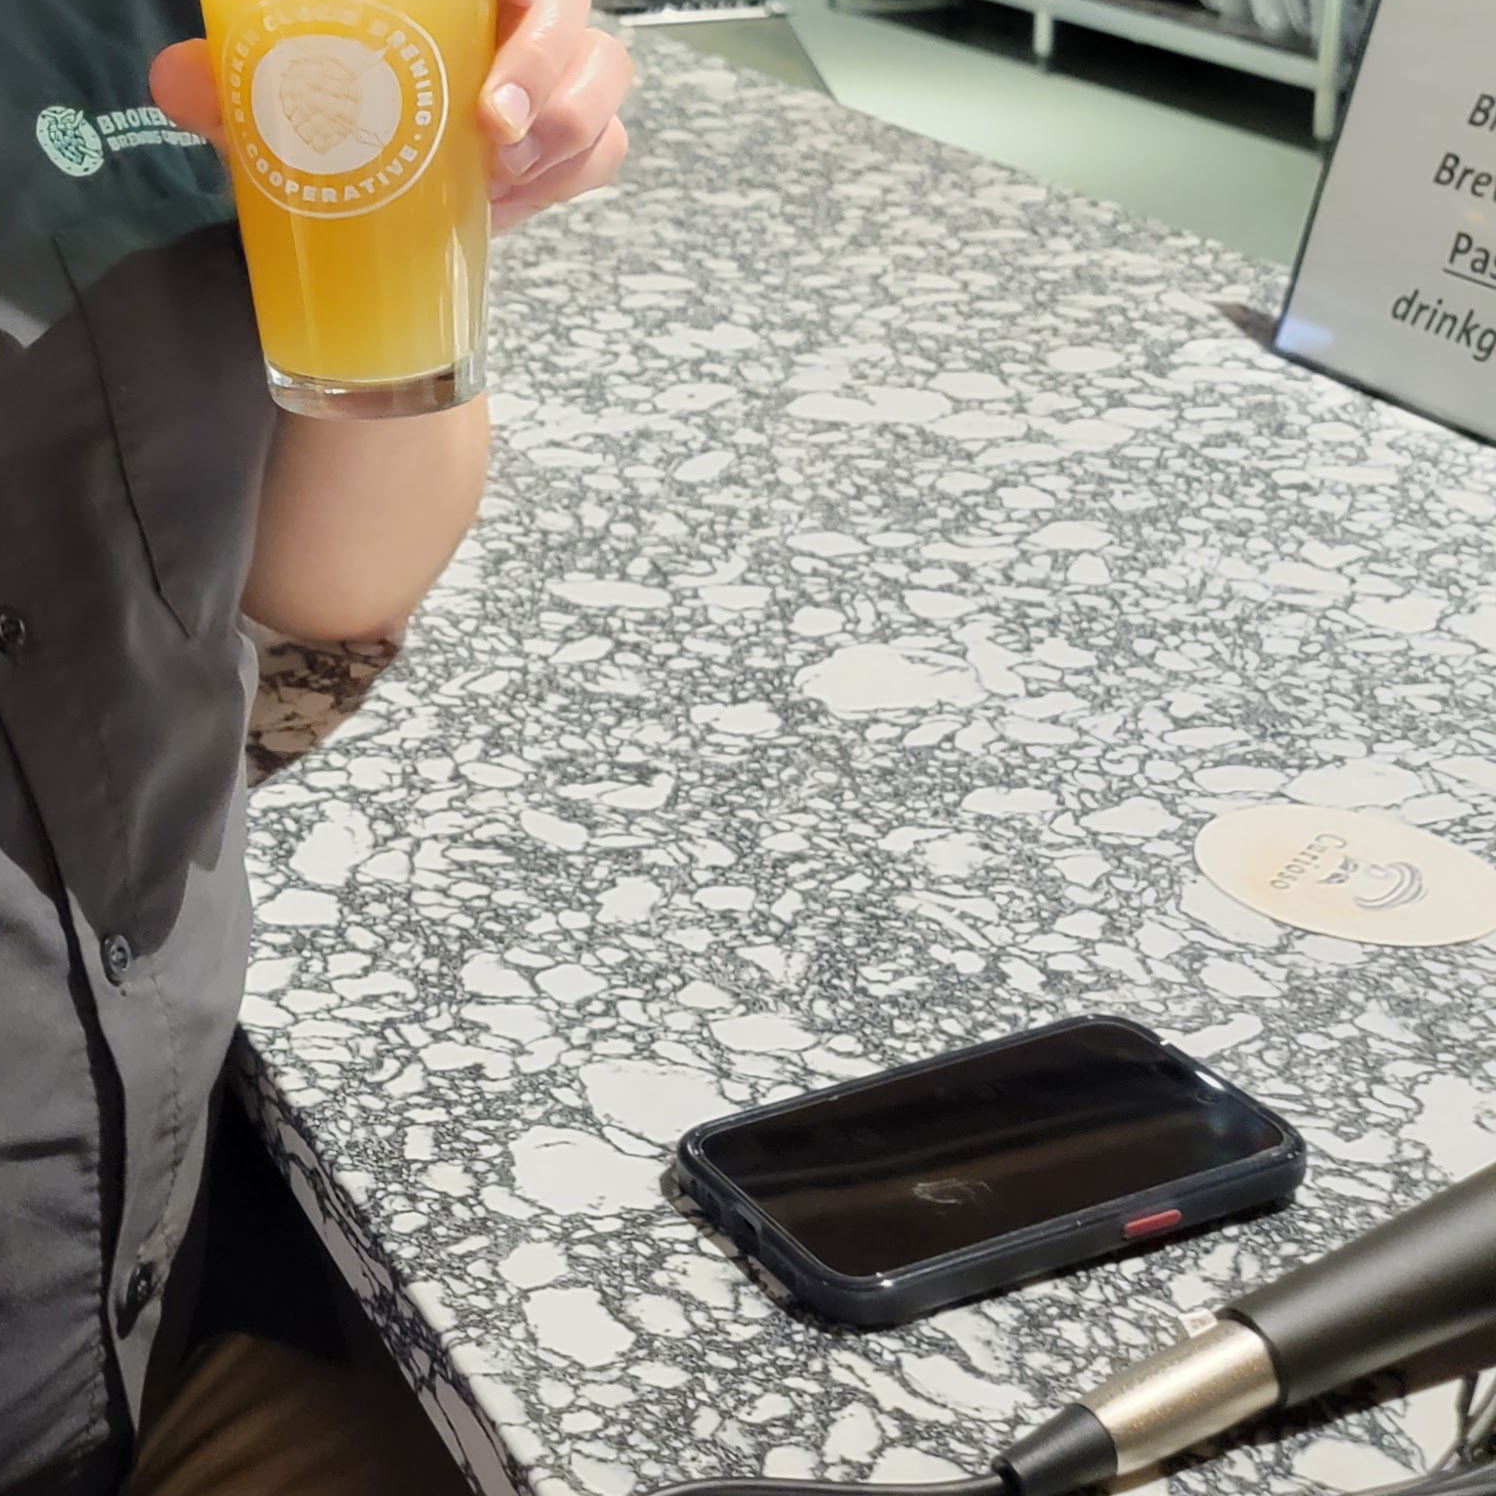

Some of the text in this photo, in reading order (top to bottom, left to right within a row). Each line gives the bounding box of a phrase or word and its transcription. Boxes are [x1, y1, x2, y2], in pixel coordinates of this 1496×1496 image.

[366, 18, 434, 126] BREWING
[245, 144, 419, 204] COOPERATIVE
[1433, 151, 1496, 204] Bre
